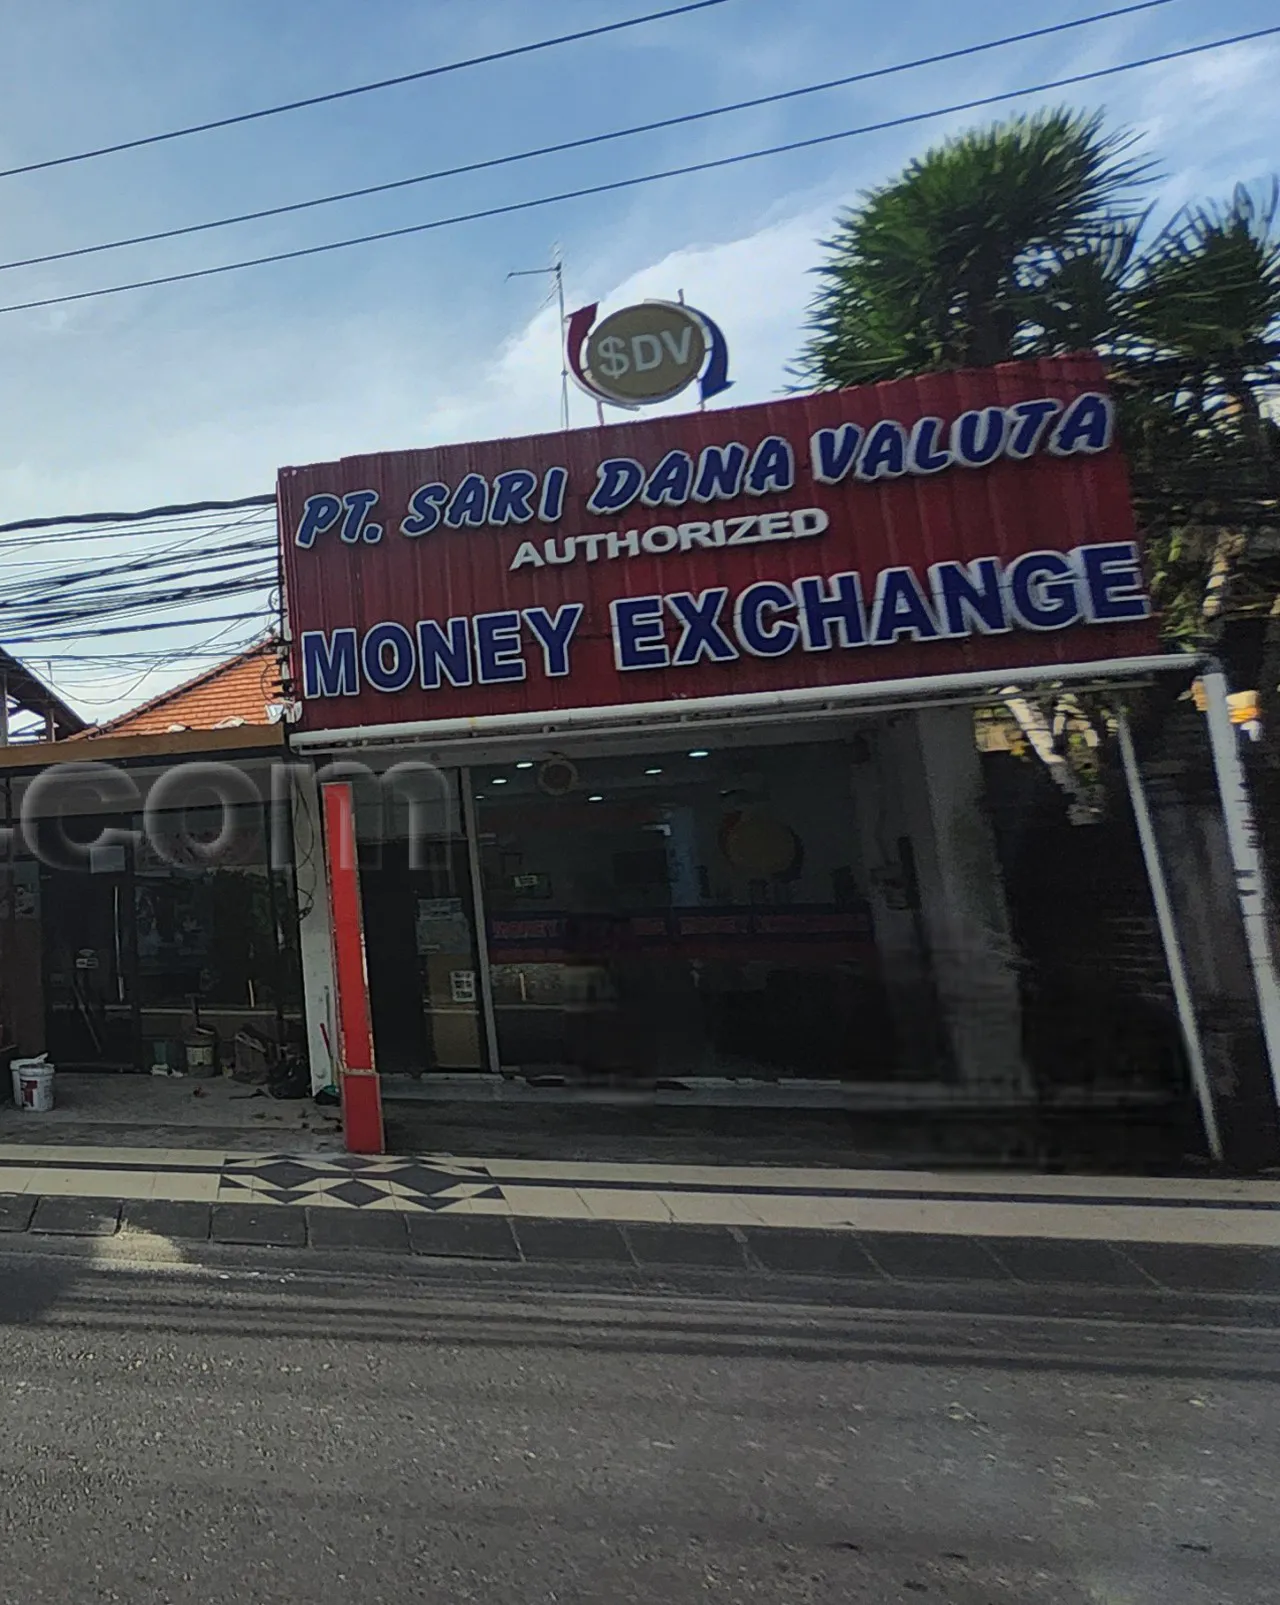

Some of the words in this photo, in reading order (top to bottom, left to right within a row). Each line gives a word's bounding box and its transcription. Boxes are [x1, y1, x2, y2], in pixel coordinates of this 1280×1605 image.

[596, 326, 693, 379] $DV
[294, 488, 383, 550] PT.
[399, 467, 567, 540] SARI
[587, 435, 795, 516] DANA
[812, 392, 1116, 482] VALUTA
[508, 507, 829, 571] AUTHORIZED
[301, 602, 584, 700] MONEY
[611, 541, 1151, 674] EXCHANGE
